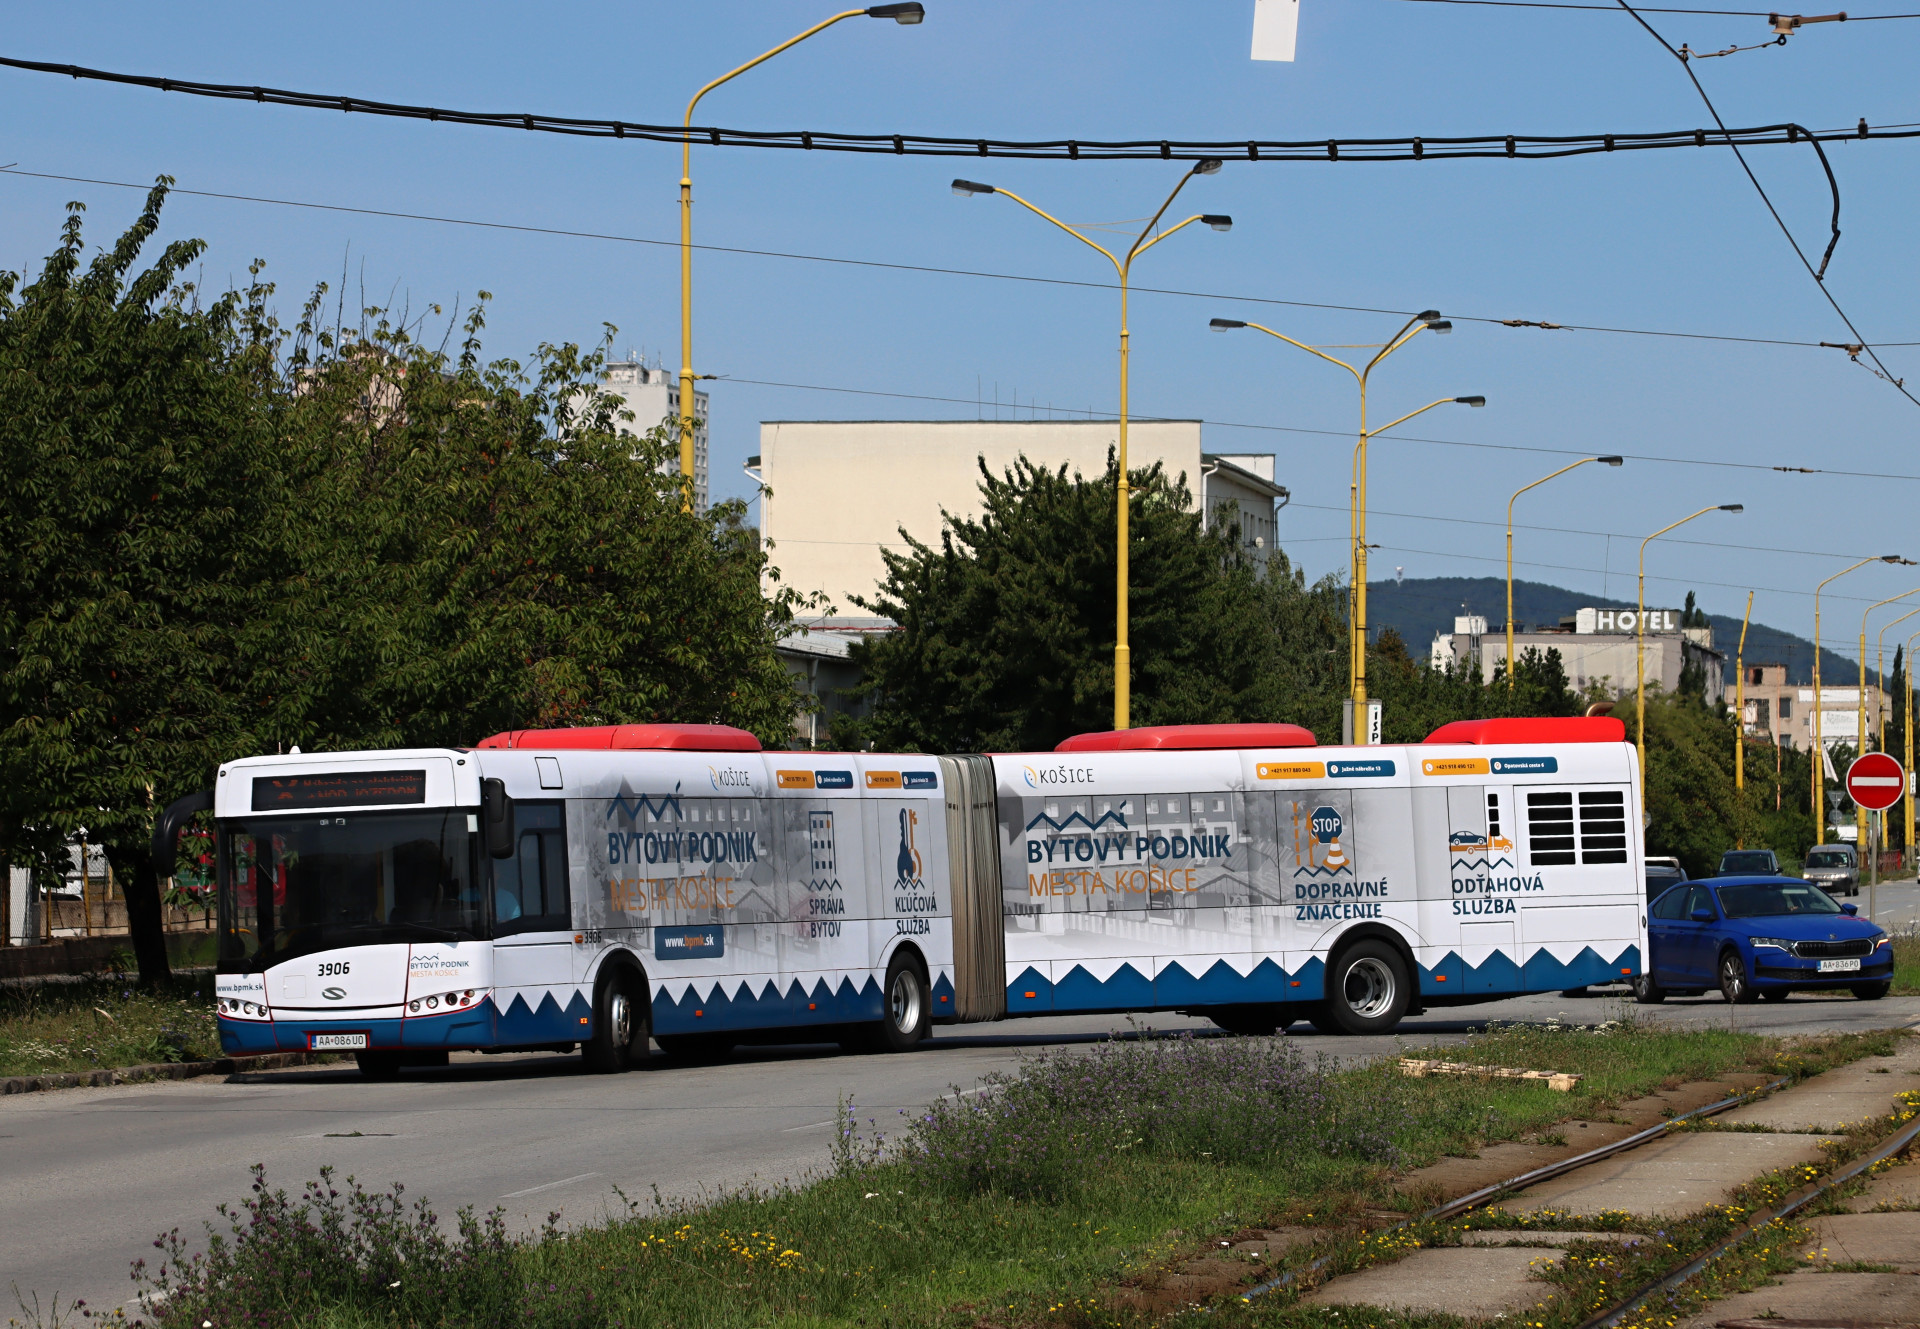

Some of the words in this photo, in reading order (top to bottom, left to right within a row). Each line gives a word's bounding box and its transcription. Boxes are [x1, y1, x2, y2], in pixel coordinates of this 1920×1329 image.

[1598, 611, 1674, 630] HOTEL
[1371, 711, 1379, 743] ISP
[719, 767, 750, 787] KOŠICE
[1040, 765, 1095, 784] KOŠICE
[1312, 818, 1341, 833] STOP
[608, 827, 684, 864] BYTOVÝ
[689, 831, 758, 864] PODNIK
[1027, 834, 1129, 863] BYTOVÝ
[1136, 834, 1232, 860] PODNIK
[610, 878, 670, 911] MESTA
[675, 869, 736, 910] KOŠICE
[1029, 871, 1107, 897] MESTA
[1115, 864, 1199, 894] KOŠICE
[1295, 877, 1388, 899] DOPRAVNÉ
[1452, 872, 1544, 894] ODŤAHOVÁ
[809, 893, 845, 915] SPRÁVA
[895, 891, 938, 913] KĽÚČOVÁ
[1296, 899, 1382, 921] ZNAČENIE
[1452, 895, 1517, 915] SLUŽBA
[810, 921, 841, 938] BYTOV
[896, 916, 931, 936] SLUŽBA
[584, 931, 602, 943] 3906
[664, 934, 714, 950] www.bpmk.sk
[317, 962, 350, 977] 3906
[410, 961, 439, 970] BYTOVÝ
[440, 960, 469, 968] PODNIK
[410, 970, 433, 978] MESTA
[434, 969, 459, 977] KOŠICE
[216, 983, 264, 993] www.bpmk.sk
